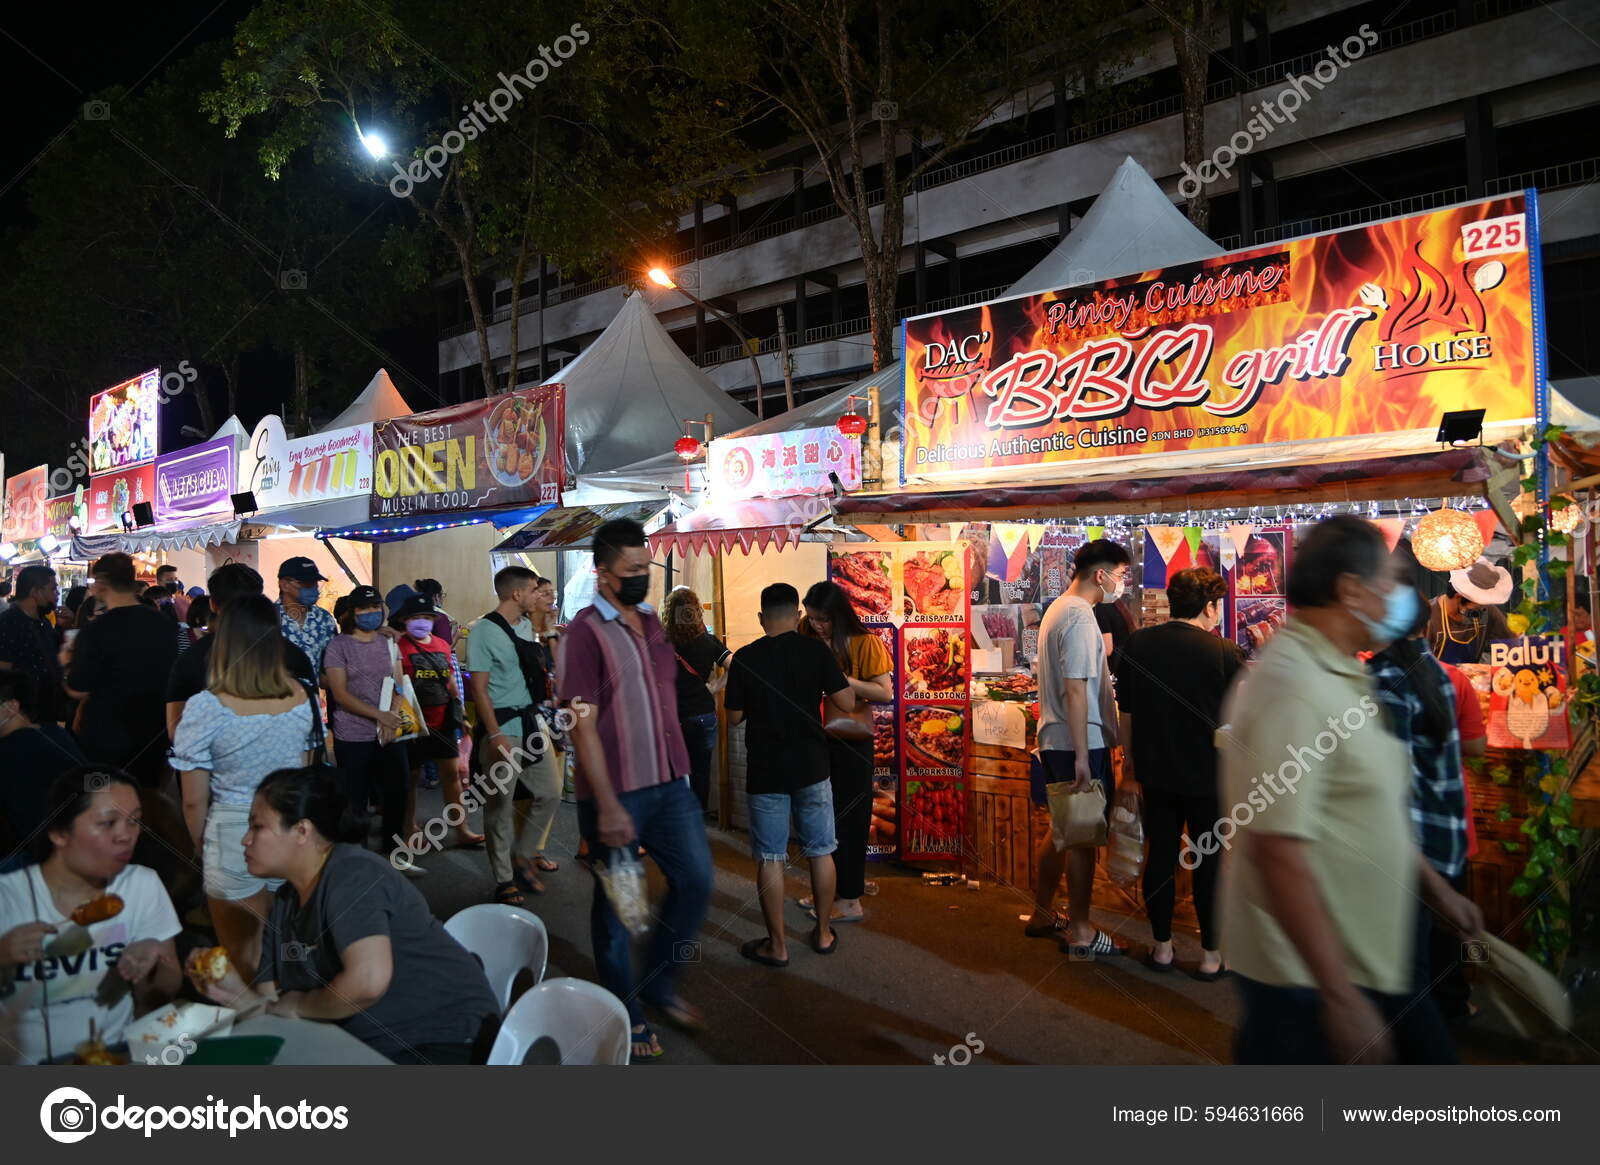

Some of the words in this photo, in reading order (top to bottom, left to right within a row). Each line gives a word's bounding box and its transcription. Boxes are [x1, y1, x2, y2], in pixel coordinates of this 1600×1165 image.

[1467, 221, 1521, 253] 225
[1048, 294, 1135, 334] Pinoy
[1145, 264, 1283, 314] Cuisine
[983, 323, 1214, 429] BBQ
[1201, 307, 1377, 416] grill
[396, 431, 418, 445] THE
[424, 424, 452, 442] BEST
[916, 442, 985, 465] Delicious
[990, 433, 1074, 457] Authentic
[1077, 426, 1148, 448] Cuisine
[1151, 431, 1171, 441] SDN
[1174, 429, 1194, 439] BHD
[374, 435, 476, 499] ODEN
[359, 477, 370, 489] 228
[541, 486, 557, 501] 227
[382, 495, 428, 513] MUSLIM
[435, 491, 469, 508] FOOD
[904, 615, 912, 623] 2.
[1490, 635, 1565, 668] Balut
[914, 691, 931, 699] BBQ
[933, 691, 966, 700] SOTONG
